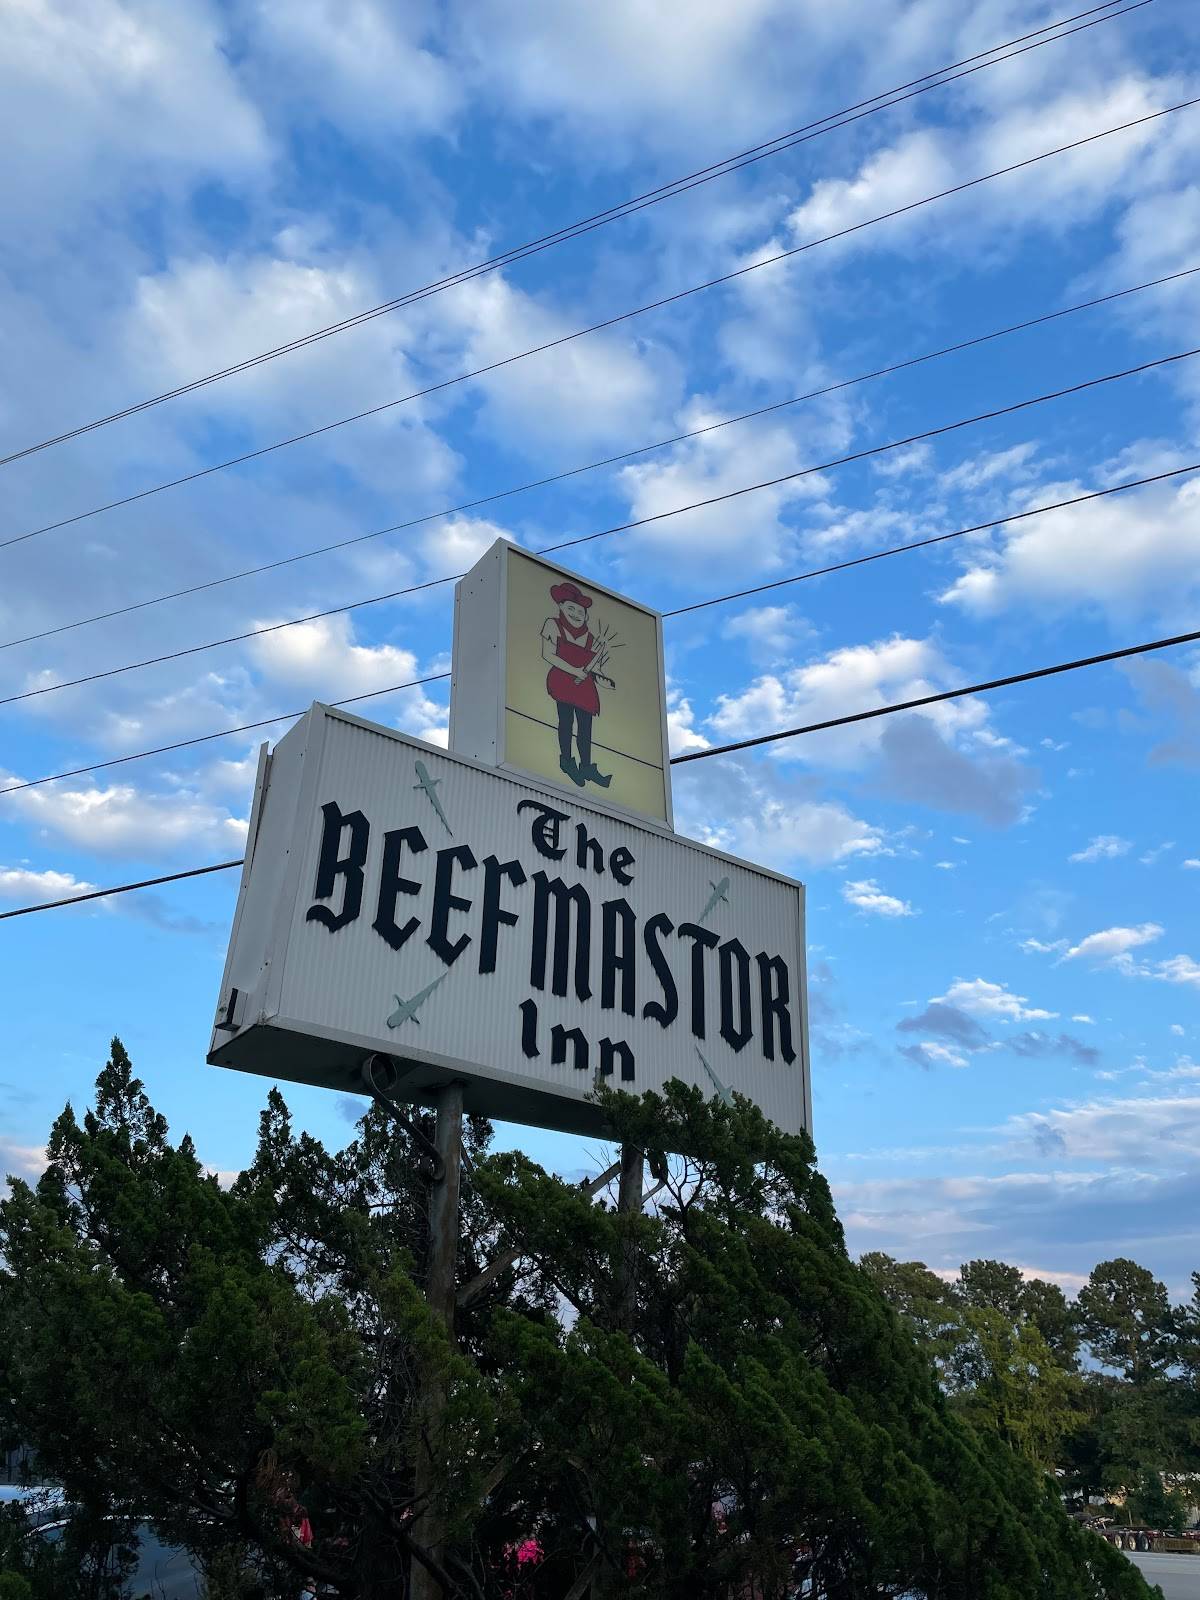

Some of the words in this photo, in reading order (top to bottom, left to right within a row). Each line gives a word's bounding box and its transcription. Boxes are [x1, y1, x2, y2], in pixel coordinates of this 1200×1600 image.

[517, 799, 637, 886] The
[306, 801, 797, 1066] BEEFMASTOR
[519, 998, 636, 1081] Inn
